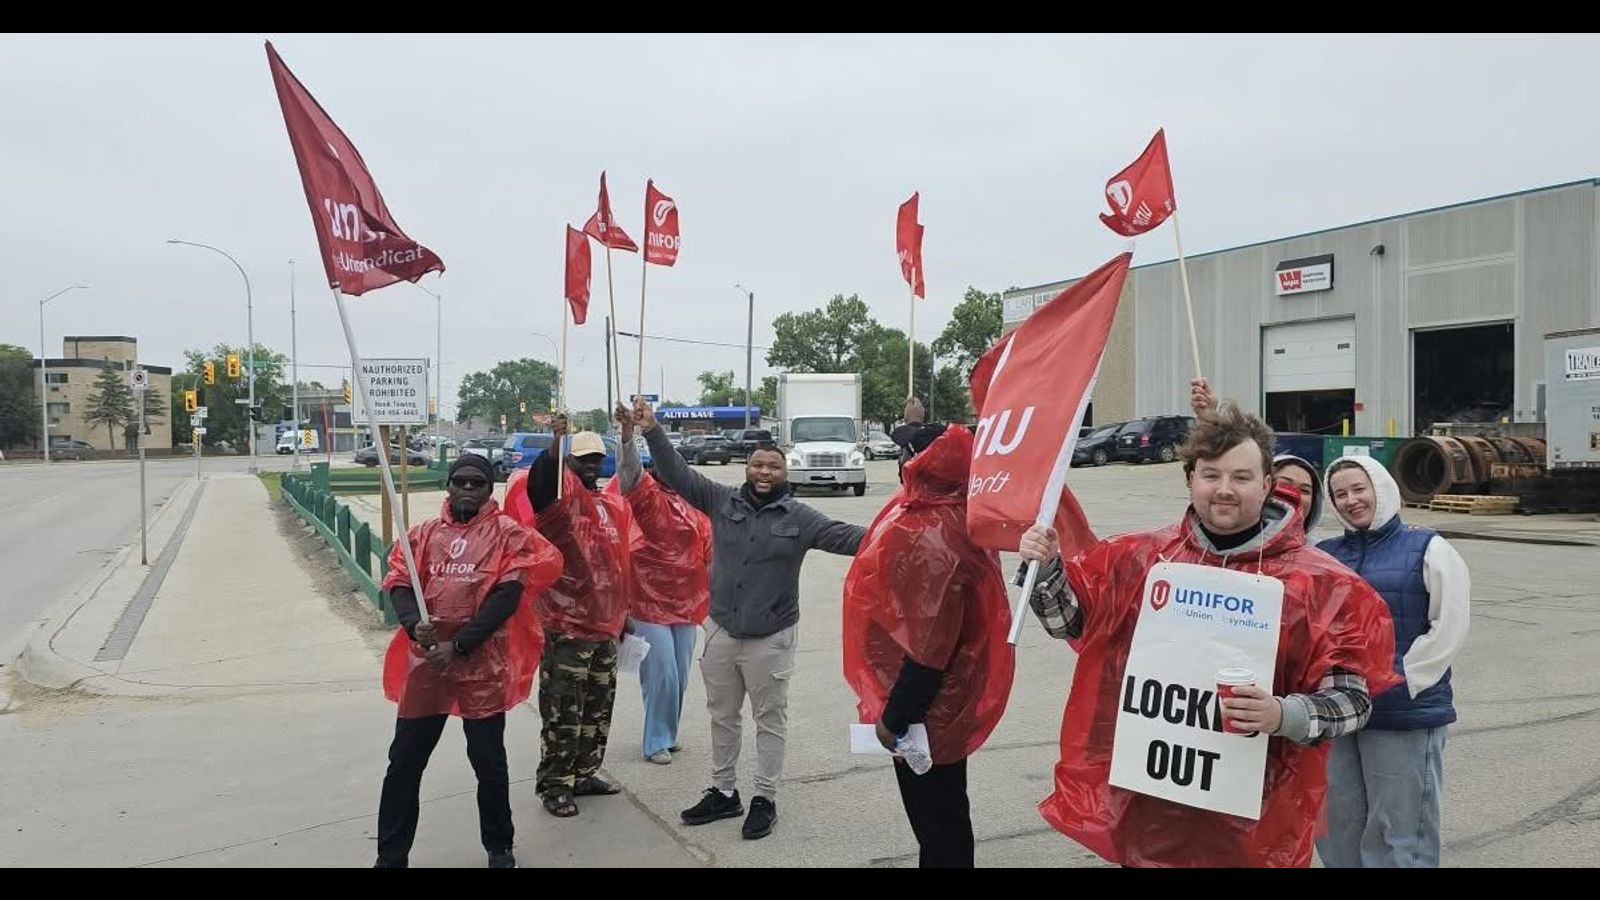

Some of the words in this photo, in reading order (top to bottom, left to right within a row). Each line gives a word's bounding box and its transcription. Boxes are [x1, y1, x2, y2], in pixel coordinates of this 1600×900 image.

[361, 365, 423, 374] NAUTHORIZED
[370, 377, 409, 386] PARKING
[369, 388, 416, 397] ROHIBITED
[1122, 675, 1259, 738] LOCK
[1146, 739, 1221, 792] OUT
